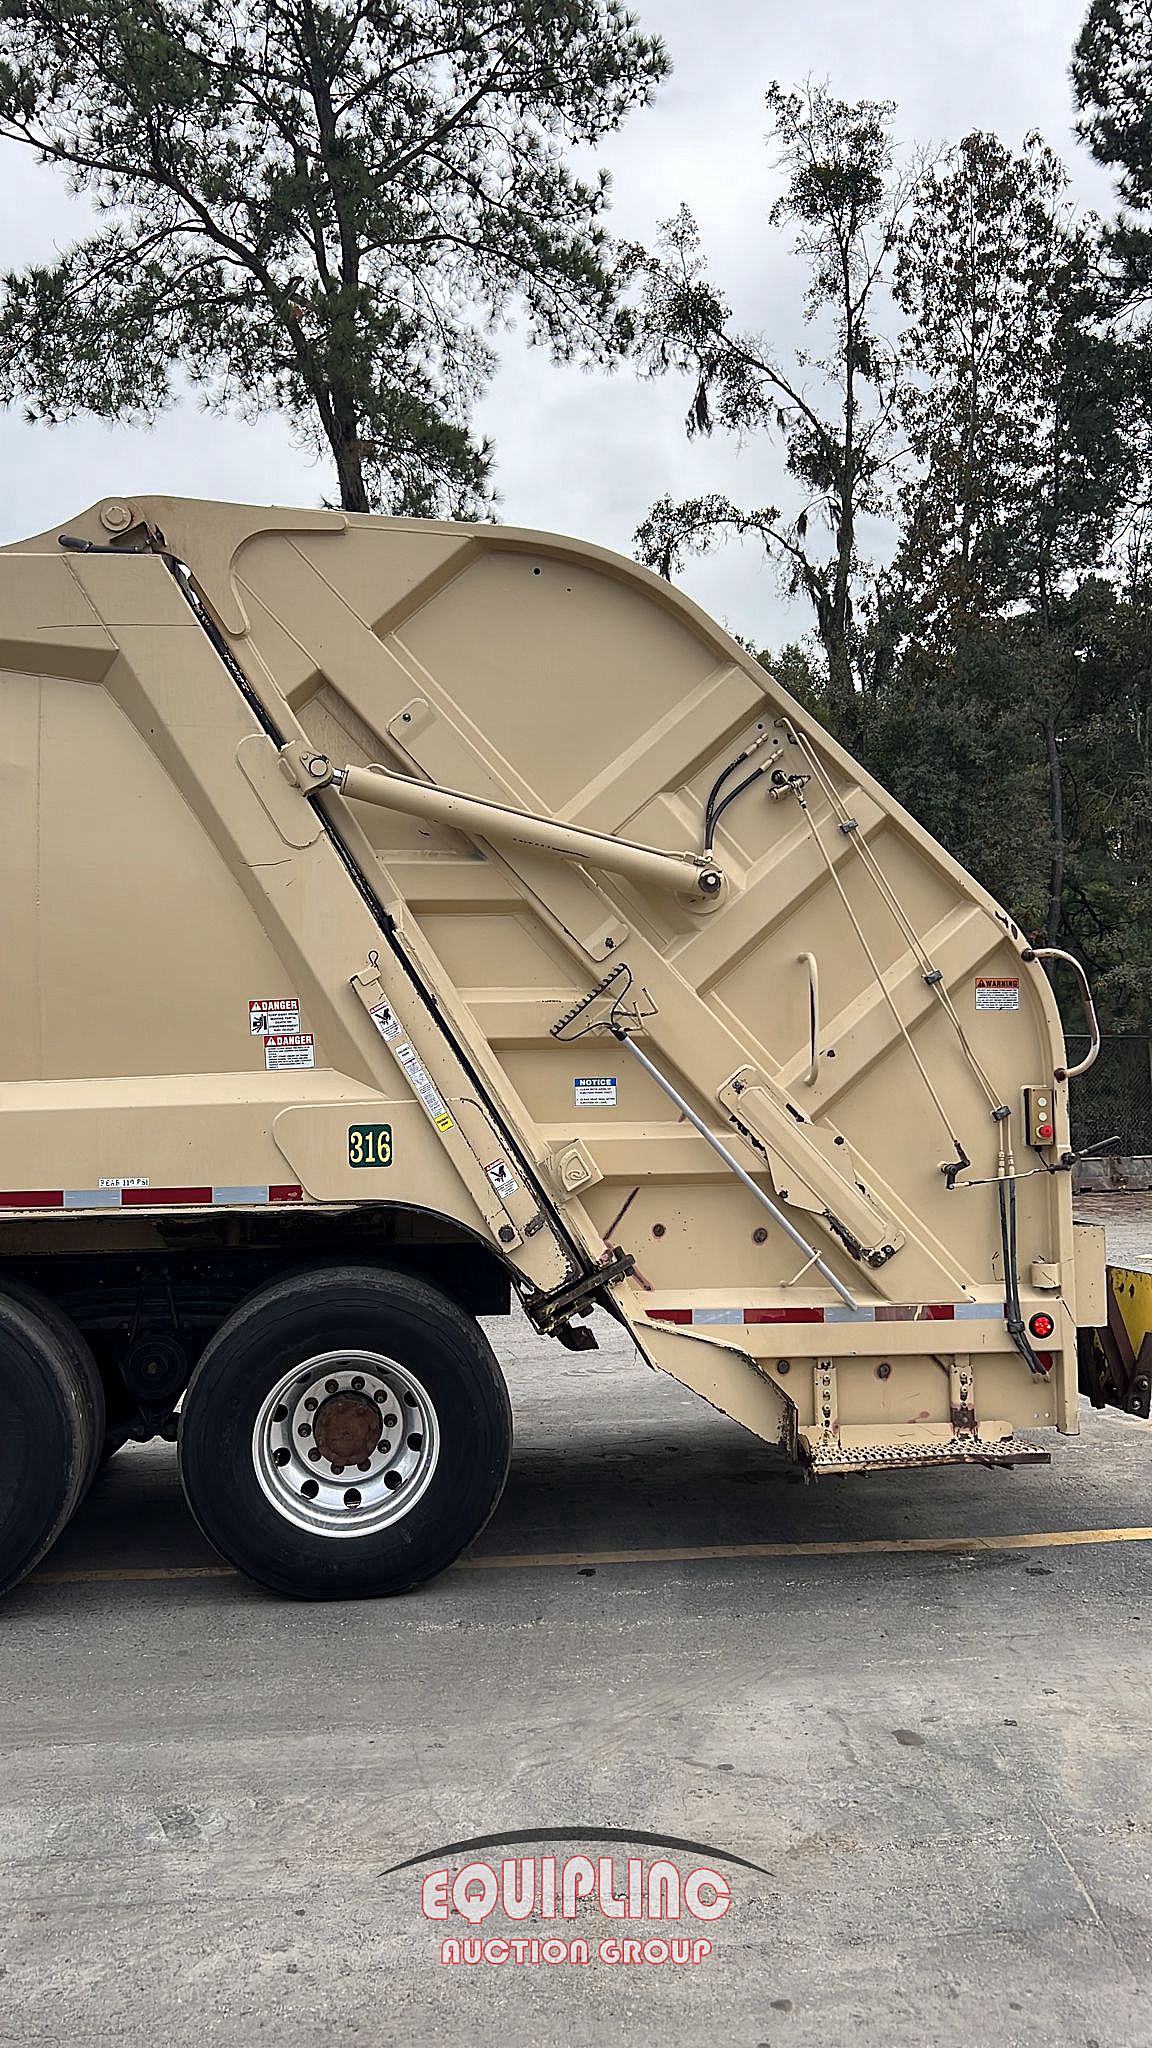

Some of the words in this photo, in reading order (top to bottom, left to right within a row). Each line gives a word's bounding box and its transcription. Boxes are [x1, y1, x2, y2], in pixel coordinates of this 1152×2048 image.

[986, 980, 1018, 988] WARNING
[262, 1001, 298, 1011] DANGER
[277, 1036, 312, 1046] DANGER
[350, 1131, 391, 1163] 316
